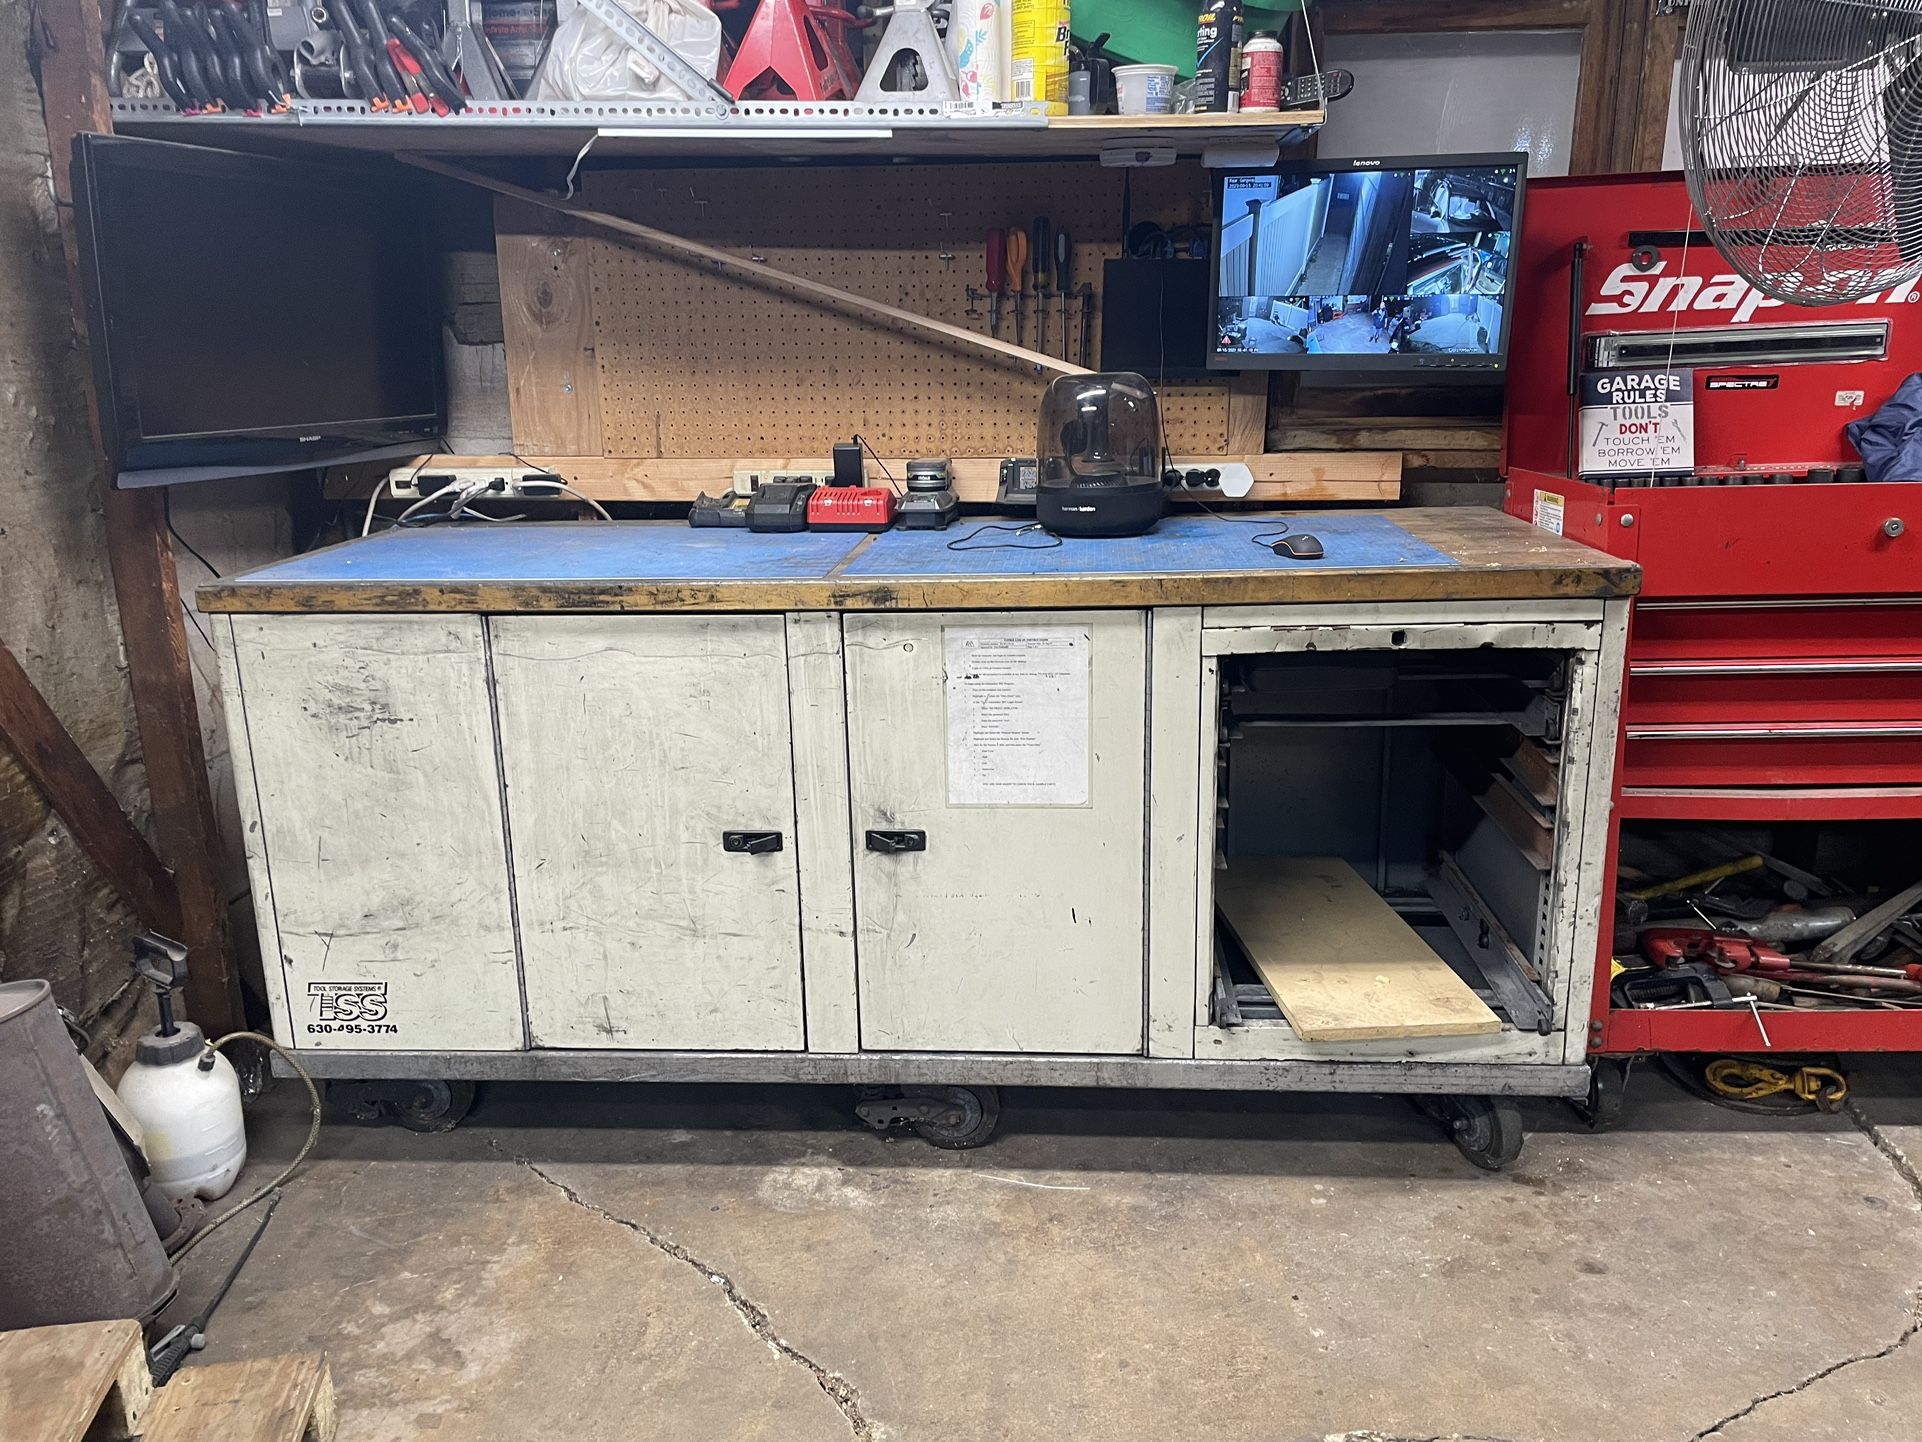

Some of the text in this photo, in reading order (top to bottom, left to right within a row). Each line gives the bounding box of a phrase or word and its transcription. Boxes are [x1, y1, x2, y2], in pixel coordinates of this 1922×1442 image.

[1597, 374, 1681, 394] GARAGE
[1612, 390, 1666, 404] RULES
[1610, 404, 1669, 421] TOOLS
[1619, 420, 1660, 434] DON'T
[1604, 436, 1650, 446] TOUCH
[1598, 446, 1681, 458] BORROW 'EM
[1608, 458, 1644, 468] MOVE
[307, 1024, 398, 1034] 630-495-3774
